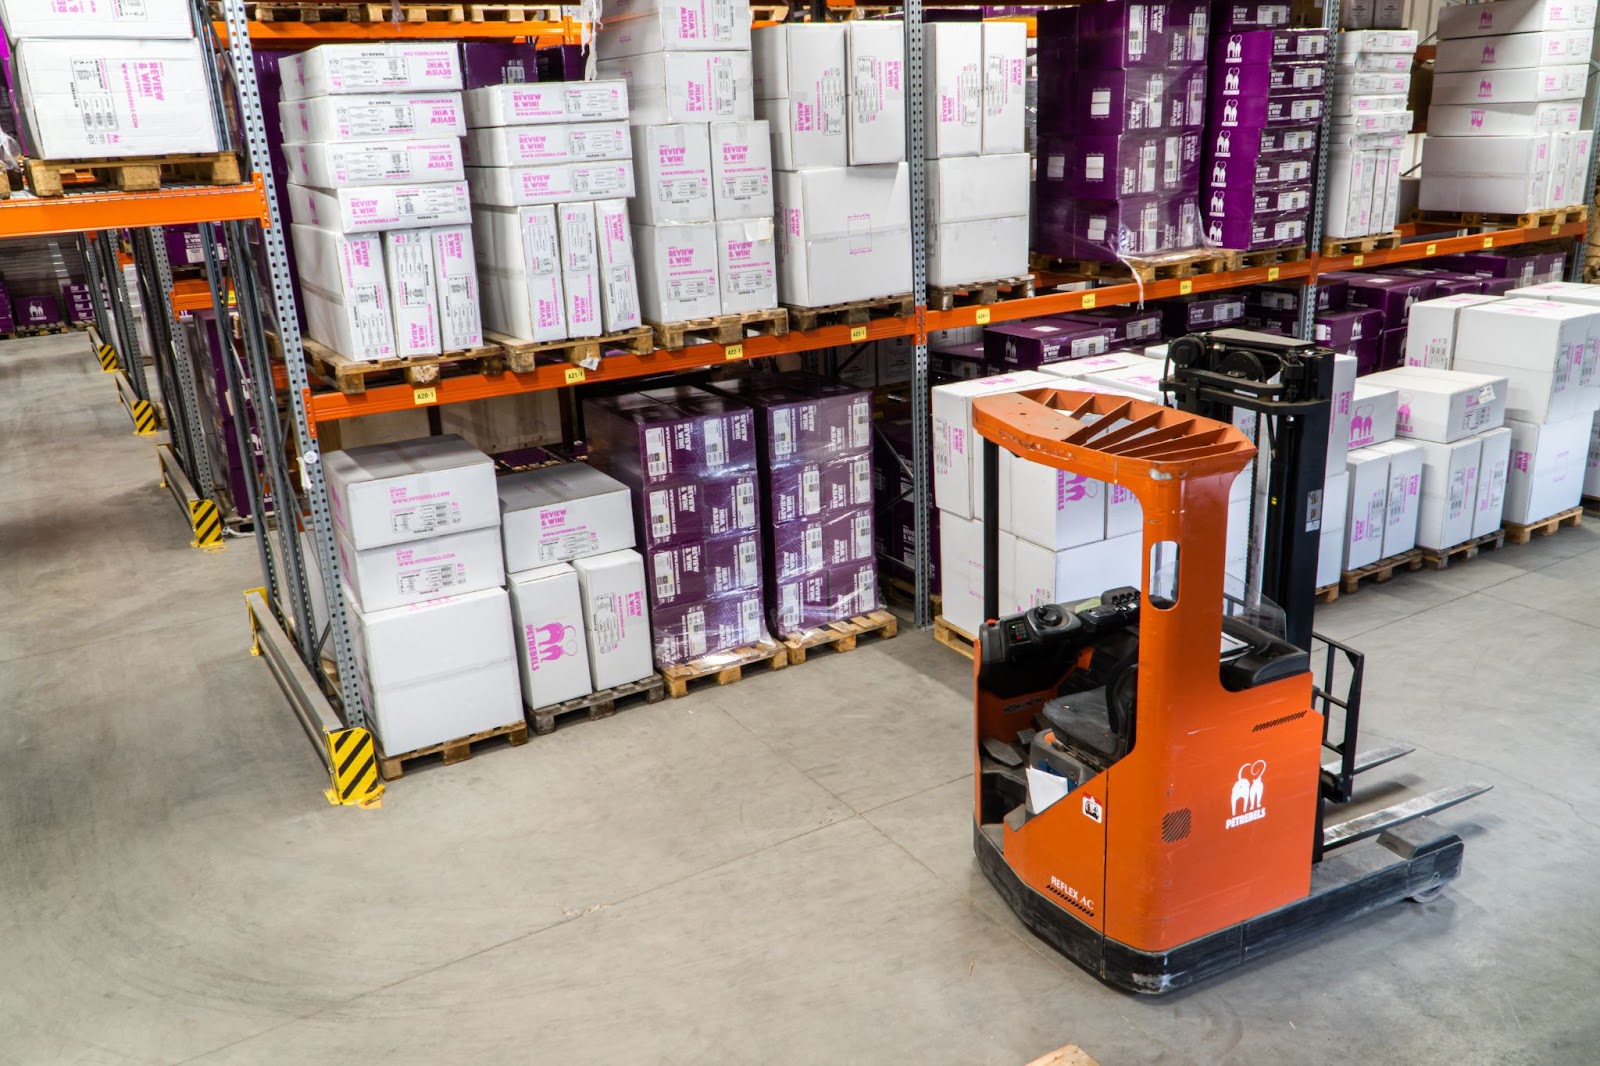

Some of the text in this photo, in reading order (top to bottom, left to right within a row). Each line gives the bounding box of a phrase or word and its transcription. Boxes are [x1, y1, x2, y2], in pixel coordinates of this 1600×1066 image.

[141, 73, 153, 97] WIN!
[149, 62, 164, 101] REVIEW
[360, 240, 370, 267] REVIEW
[453, 233, 463, 259] REVIEW
[669, 249, 694, 257] REVIEW
[568, 371, 584, 379] A21-1
[684, 423, 692, 451] REVIEW
[687, 485, 695, 512] REVIEW
[540, 509, 567, 520] REVIEW
[526, 624, 540, 671] PETREBELS
[1226, 807, 1266, 829] PETREBELS
[1051, 876, 1094, 910] REFLEX AC
